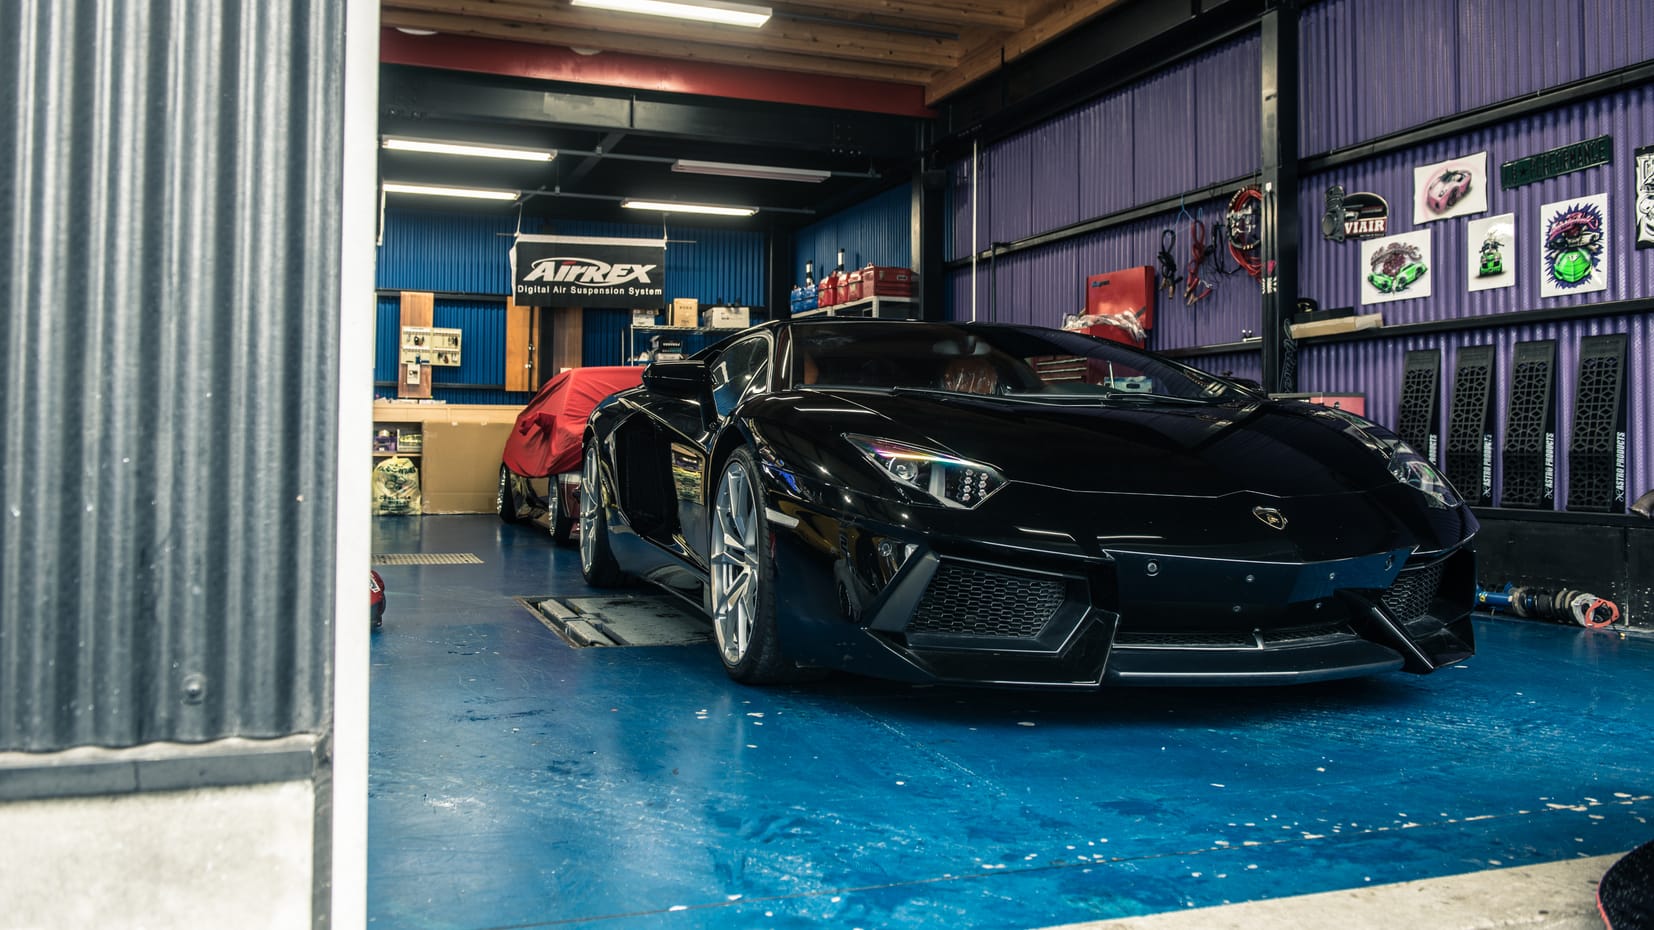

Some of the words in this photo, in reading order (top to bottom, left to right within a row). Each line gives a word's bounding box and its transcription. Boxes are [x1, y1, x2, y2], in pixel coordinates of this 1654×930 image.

[1344, 219, 1385, 234] VIAIR
[517, 284, 550, 295] Digital
[553, 285, 566, 294] Air
[570, 286, 625, 296] Suspension
[628, 287, 662, 296] System
[1545, 432, 1555, 467] PRODUCTS
[1616, 431, 1626, 467] PRODUCTS
[1483, 466, 1492, 488] ASTRO
[1544, 467, 1554, 489] ASTRO
[1615, 467, 1625, 490] ASTRO
